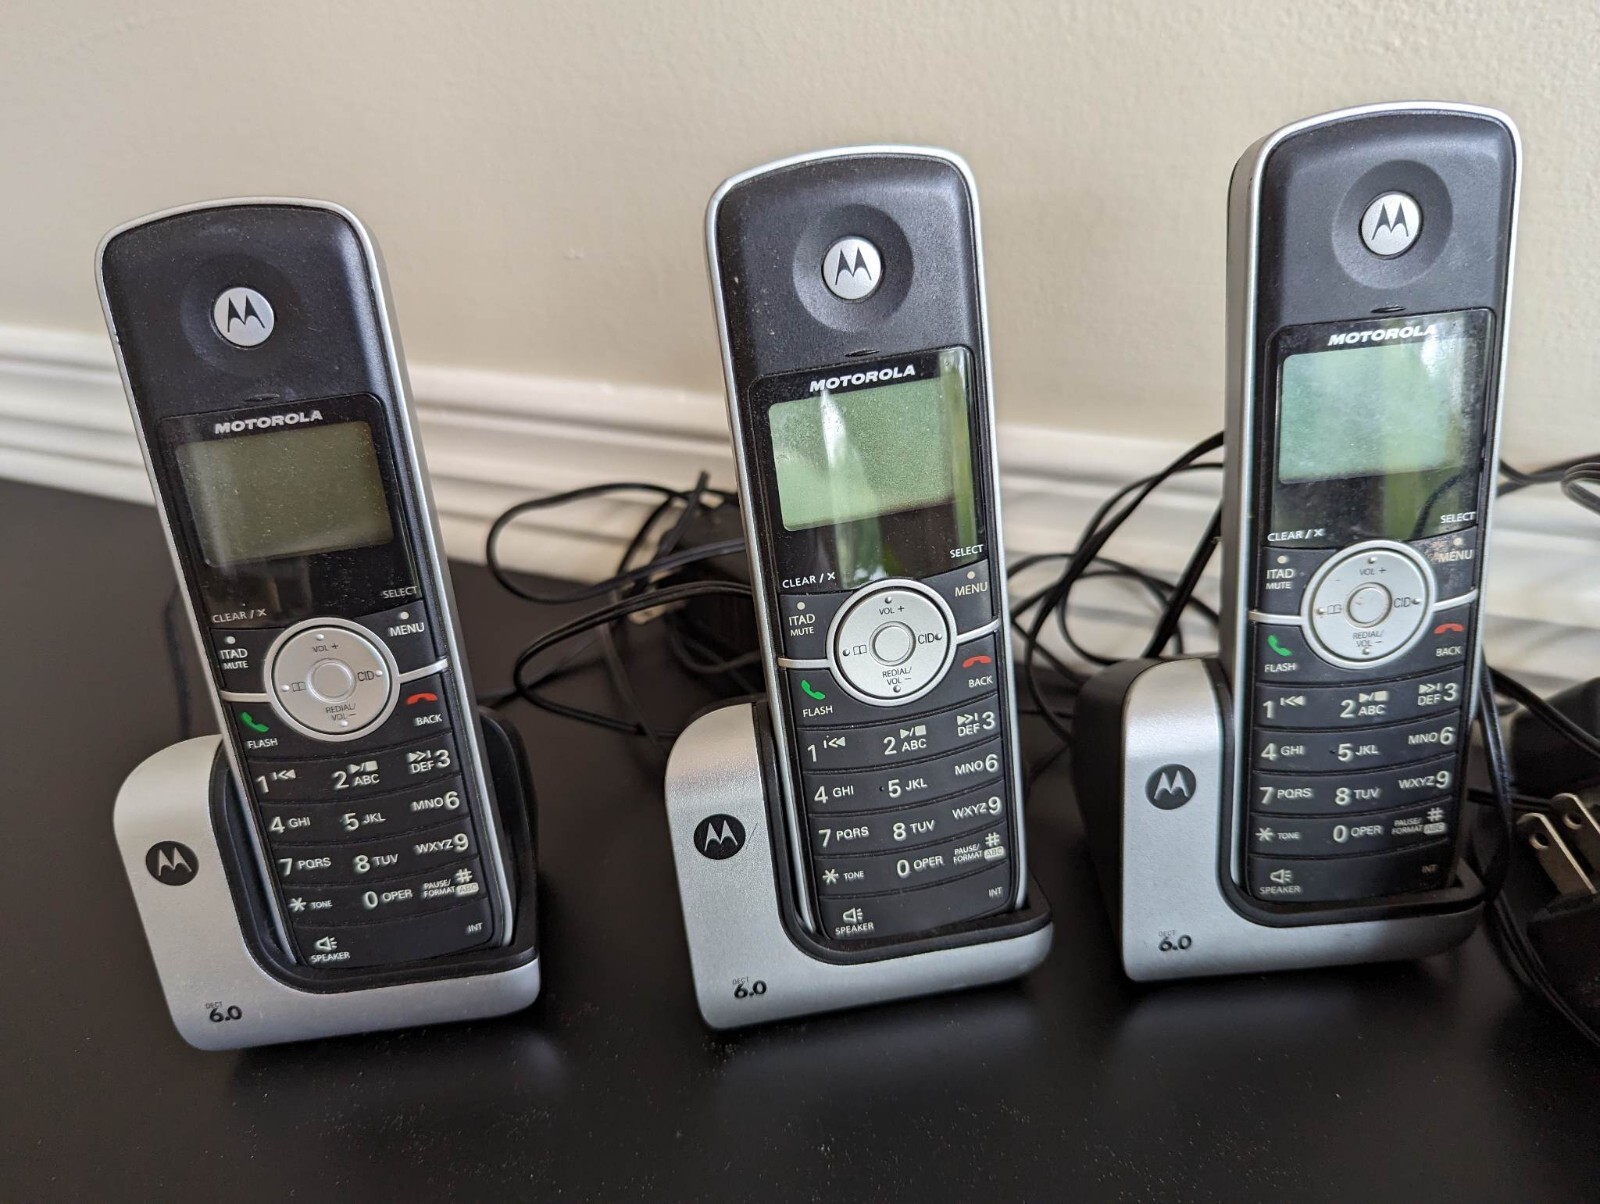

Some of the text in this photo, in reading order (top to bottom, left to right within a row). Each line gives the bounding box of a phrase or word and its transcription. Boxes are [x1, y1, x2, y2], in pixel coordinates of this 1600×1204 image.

[1328, 325, 1437, 346] MOTOROLA
[810, 364, 916, 393] MOTOROLA
[214, 409, 323, 434] MOTOROLA
[1440, 511, 1476, 524] SELECT
[1267, 530, 1303, 542] CLEAR
[950, 544, 984, 558] SELECT
[1438, 549, 1473, 562] MENU
[1266, 569, 1294, 579] ITAD
[782, 575, 816, 589] CLEAR
[954, 581, 988, 597] MENU
[1266, 581, 1292, 590] MUTE
[382, 585, 418, 599] SELECT
[1393, 597, 1411, 608] CID
[212, 611, 247, 624] CLEAR
[879, 607, 895, 615] VOL
[788, 613, 816, 626] ITAD
[389, 623, 425, 637] MENU
[790, 626, 815, 637] MUTE
[918, 632, 934, 644] CID
[1356, 639, 1372, 648] VOL
[220, 648, 248, 659] ITAD
[312, 645, 330, 653] VOL
[1436, 646, 1462, 657] BACK
[223, 660, 249, 670] MUTE
[1264, 663, 1297, 673] FLASH
[357, 671, 375, 682] CID
[886, 676, 902, 686] VOL
[968, 675, 994, 688] BACK
[1417, 682, 1458, 706] DEF 3
[802, 706, 833, 718] FLASH
[1263, 700, 1274, 719] 1
[1340, 700, 1386, 718] 2 ABC
[331, 713, 347, 722] VOL
[414, 714, 442, 726] BACK
[958, 711, 996, 738] DEF 3
[247, 738, 278, 749] FLASH
[883, 736, 927, 756] 2 ABC
[807, 744, 817, 763] 1
[1261, 743, 1305, 761] 4 GHI
[1338, 743, 1380, 762] 5 JKL
[409, 749, 450, 774] DEF 3
[256, 775, 269, 794] 1
[333, 771, 380, 790] 2 ABC
[814, 786, 855, 804] 4 GHI
[888, 778, 928, 799] 5 JKL
[1259, 786, 1313, 804] 7 PQRS
[1334, 787, 1380, 806] 8 TUV
[270, 816, 311, 834] 4 GHI
[342, 812, 386, 831] 5 JKL
[818, 826, 869, 848] 7 PQRS
[893, 820, 935, 841] 8 TUV
[1278, 832, 1301, 840] TONE
[1333, 824, 1383, 842] 0 OPER
[1391, 825, 1423, 835] FORMAT
[354, 854, 399, 874] 8 TUV
[952, 851, 983, 864] FORMAT
[278, 857, 332, 876] 7 PQRS
[896, 855, 944, 879] 0 OPER
[1422, 865, 1438, 873] INT
[843, 870, 865, 881] TONE
[423, 887, 455, 899] FORMAT
[988, 887, 1003, 897] INT
[1259, 885, 1301, 894] SPEAKER
[310, 900, 332, 910] TONE
[363, 889, 413, 910] 0 OPER
[466, 922, 483, 935] INT
[835, 922, 874, 936] SPEAKER
[1158, 934, 1192, 951] 6.0
[310, 951, 351, 964] SPEAKER
[734, 980, 767, 999] 6.0
[209, 1005, 243, 1023] 6.0
